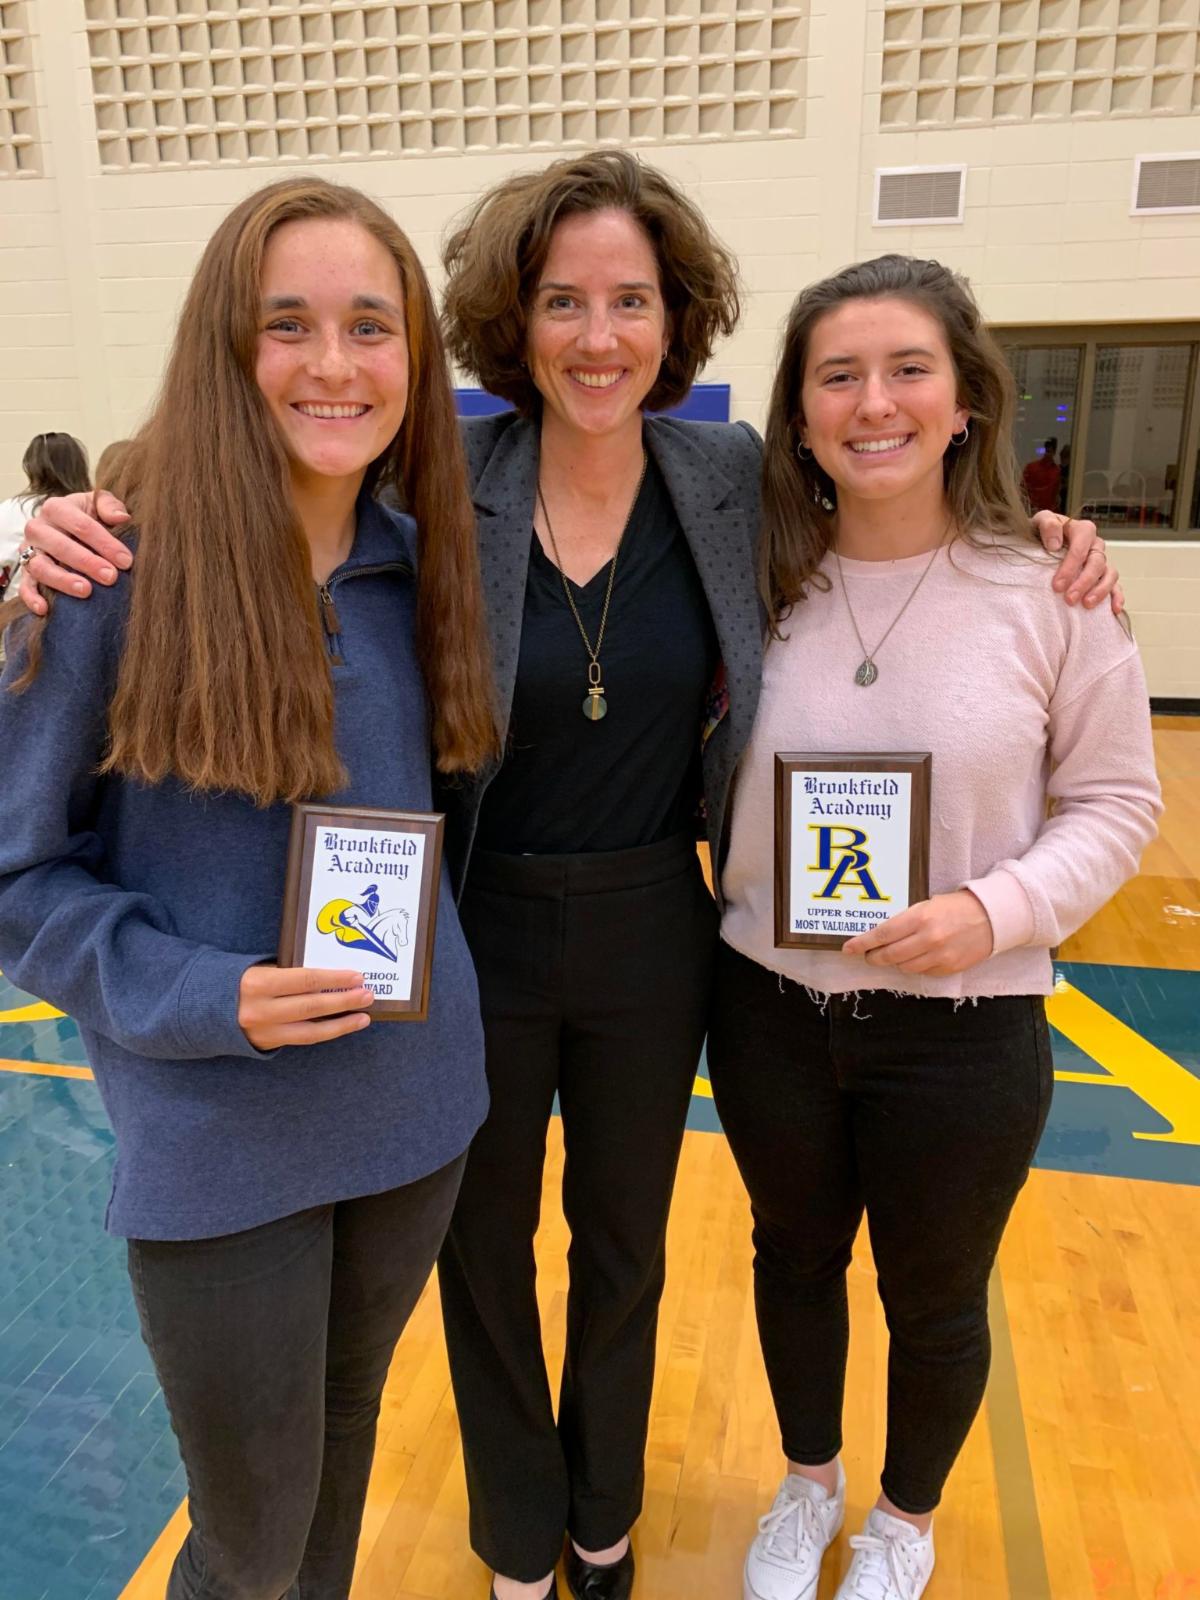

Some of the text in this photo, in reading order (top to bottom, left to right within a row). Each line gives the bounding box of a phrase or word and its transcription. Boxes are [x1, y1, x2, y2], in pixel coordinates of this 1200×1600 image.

[804, 776, 899, 796] Brookfield
[809, 797, 892, 820] Academy
[324, 832, 417, 856] Brookfield
[327, 854, 409, 880] Academy
[807, 908, 890, 919] UPPER SCHOOL
[795, 919, 820, 930] MOST
[822, 920, 867, 932] VALUABLE
[360, 971, 399, 981] CHOOL
[360, 983, 393, 995] WARD
